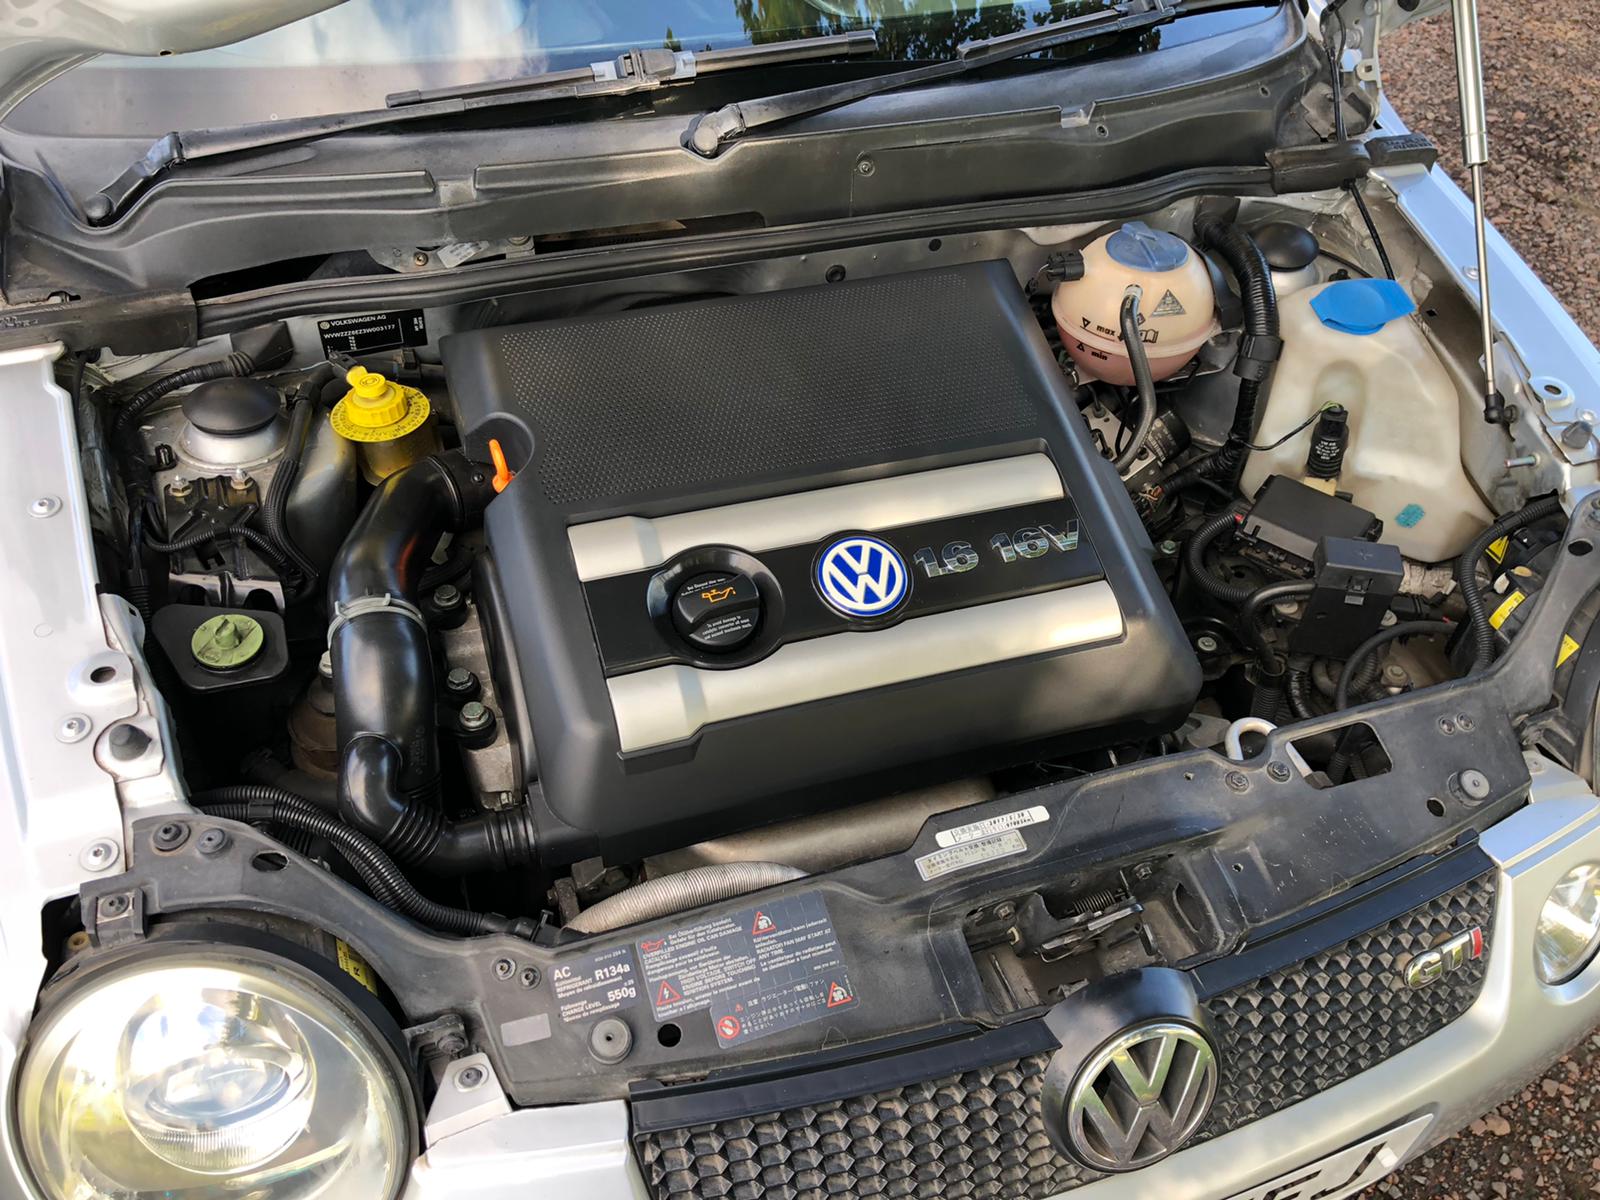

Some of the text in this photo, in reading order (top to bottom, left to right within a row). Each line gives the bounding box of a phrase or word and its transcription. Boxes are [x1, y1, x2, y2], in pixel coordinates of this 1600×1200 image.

[331, 316, 376, 326] VOLKSWAGEN
[1096, 324, 1116, 337] max
[1091, 351, 1108, 361] min
[990, 519, 1079, 563] 16V
[1404, 927, 1482, 989] GTI
[554, 966, 571, 980] AC
[595, 964, 630, 980] R134a
[608, 987, 636, 1001] 550g
